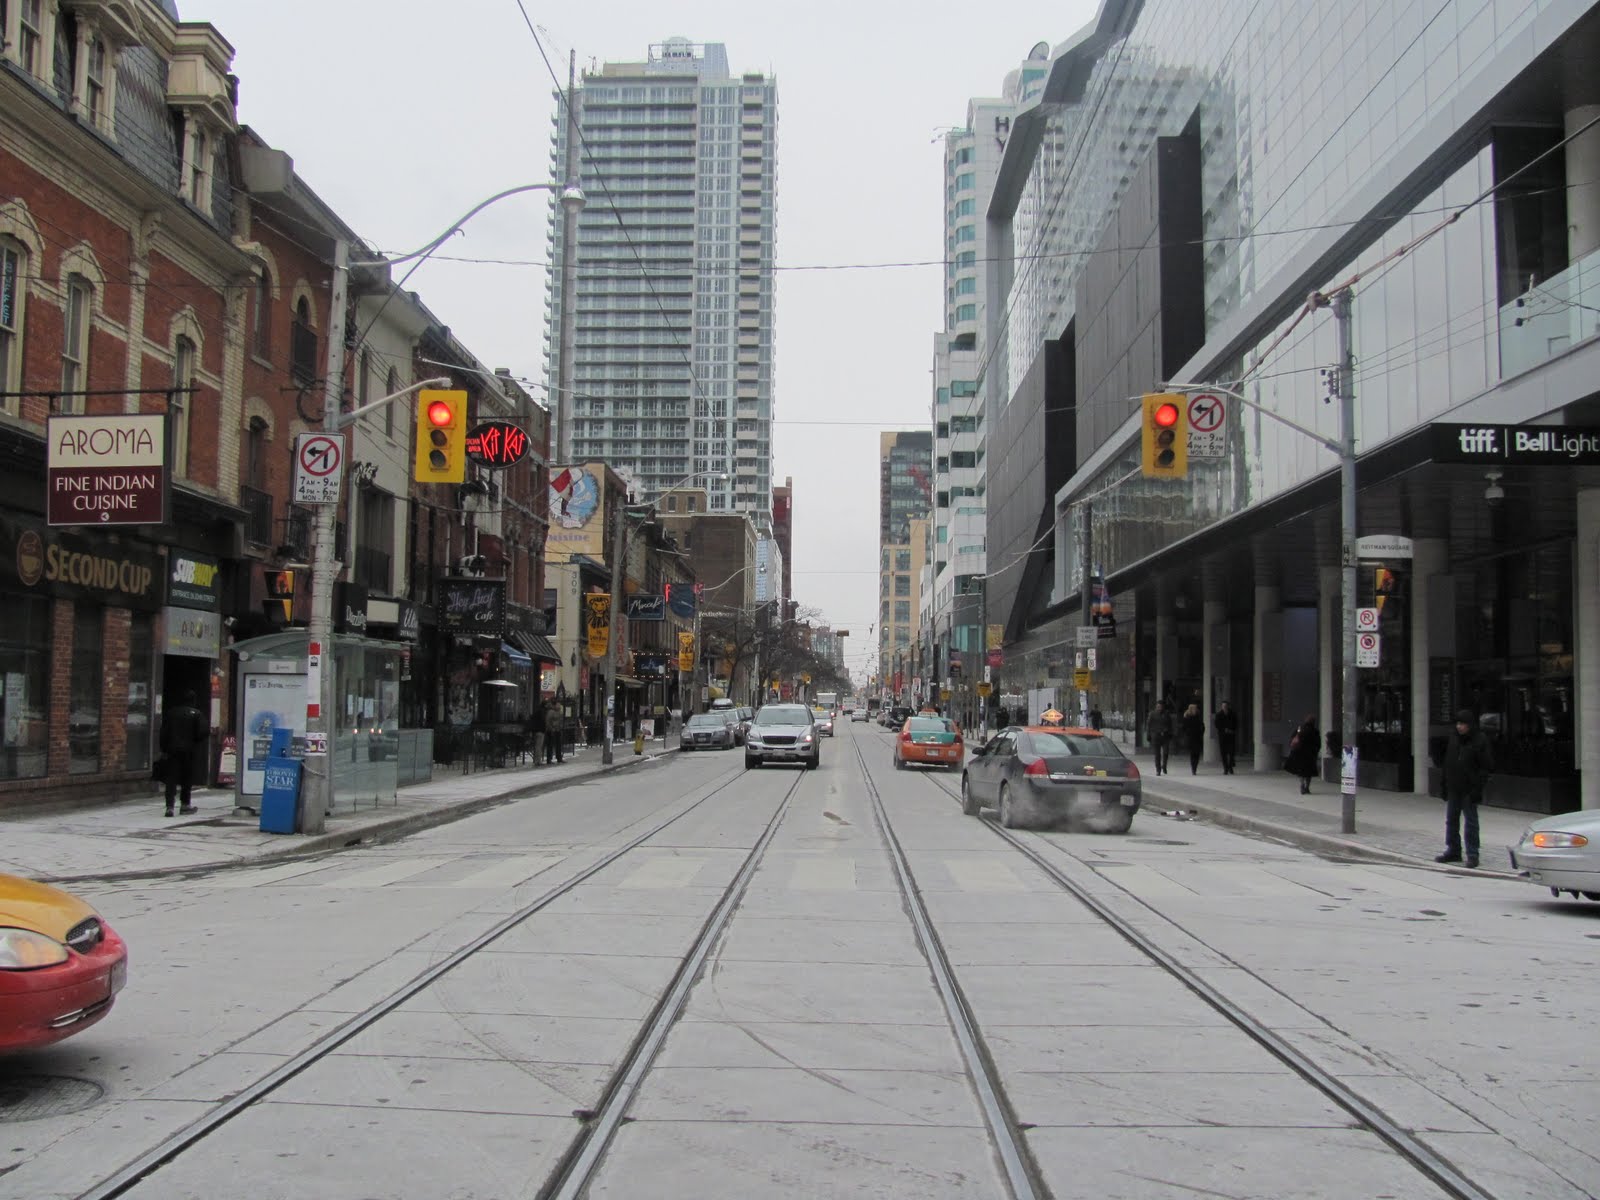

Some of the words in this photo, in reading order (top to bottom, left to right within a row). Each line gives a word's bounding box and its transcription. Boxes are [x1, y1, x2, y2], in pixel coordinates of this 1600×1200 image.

[59, 428, 153, 455] AROMA
[1459, 428, 1499, 453] tiff.
[56, 476, 90, 491] FINE
[95, 474, 155, 490] INDIAN
[73, 494, 138, 511] CUISINE
[173, 558, 218, 587] SUBWAY
[266, 775, 294, 787] STAR
